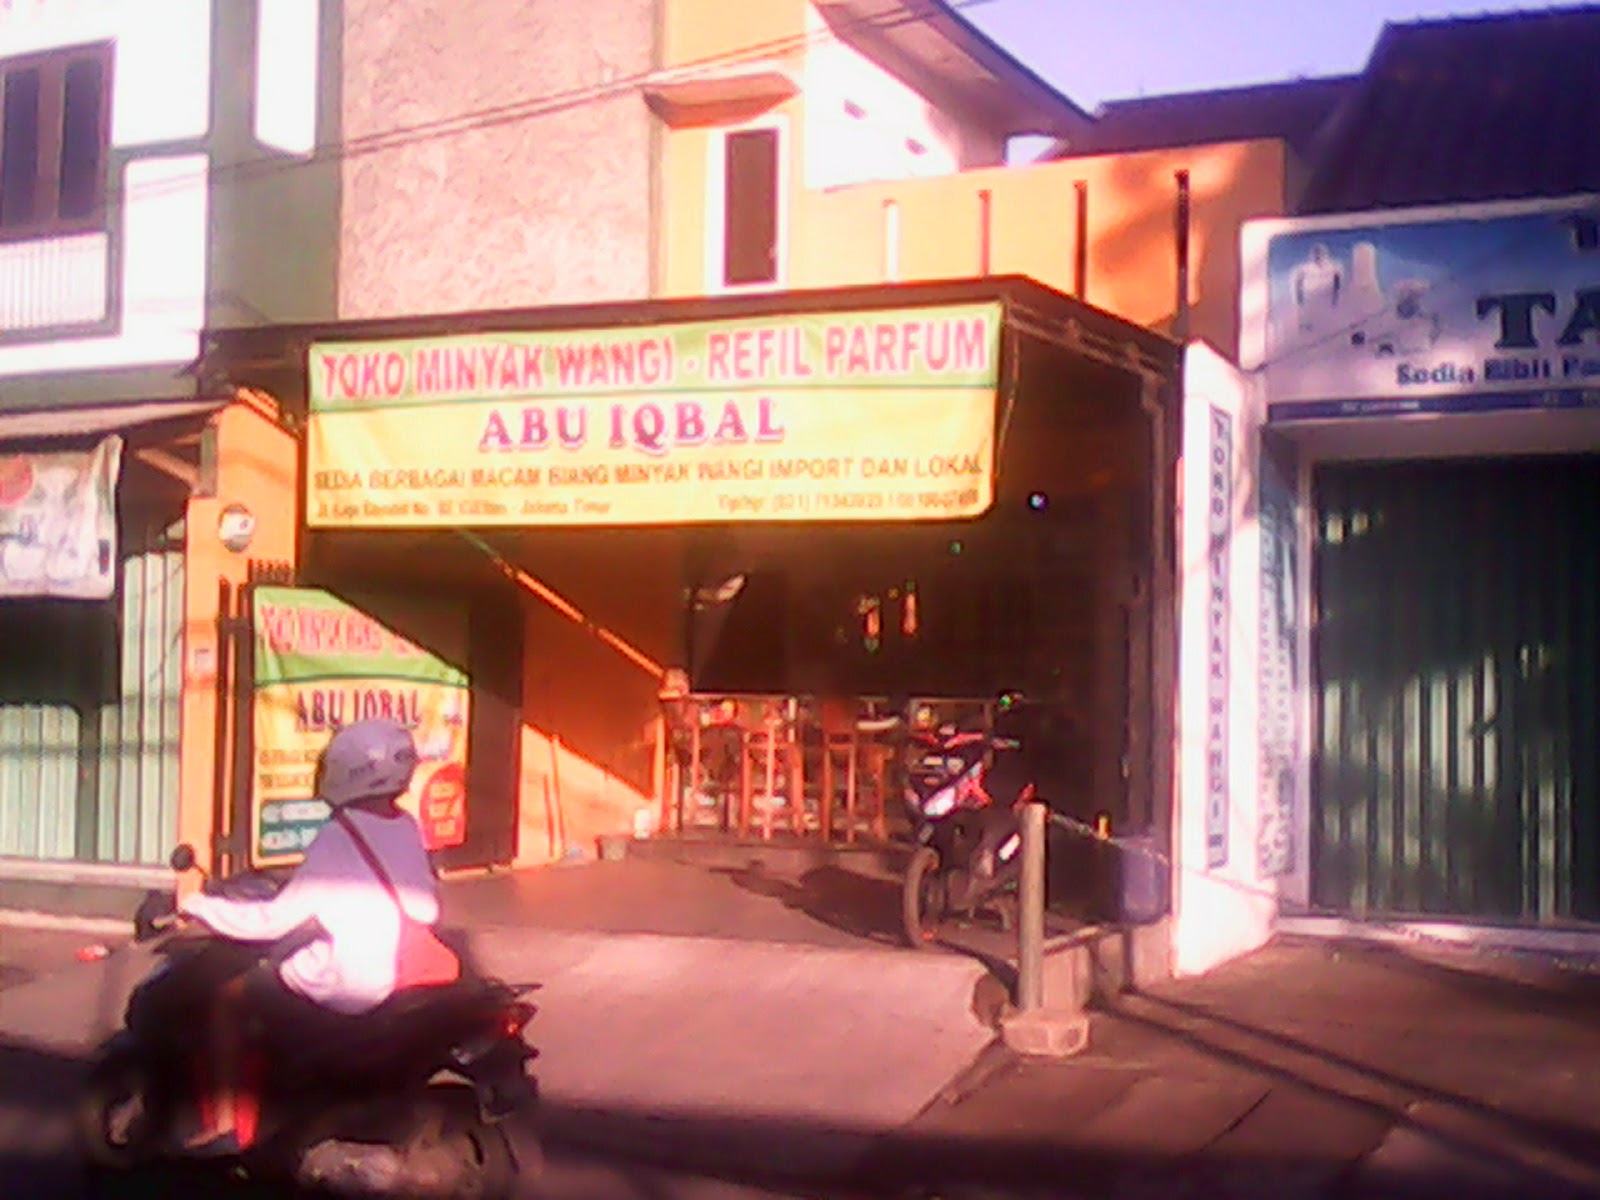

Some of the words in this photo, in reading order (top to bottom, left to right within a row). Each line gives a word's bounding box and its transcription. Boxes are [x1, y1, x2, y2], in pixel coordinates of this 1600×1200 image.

[321, 352, 405, 399] TOKO
[415, 344, 544, 394] MINYAK
[554, 337, 673, 389] WANGI
[707, 327, 813, 381] REFIL
[826, 317, 987, 375] PARFUM
[1396, 362, 1475, 386] Sedia
[480, 406, 588, 453] ABU
[608, 397, 785, 459] IQBAL
[471, 466, 541, 488] MACAM
[614, 462, 689, 484] MINYAK
[698, 459, 764, 480] WANGI
[769, 457, 855, 479] IMPORT
[861, 456, 908, 477] DAN
[915, 453, 983, 477] LOKAL
[297, 690, 345, 731] ABU
